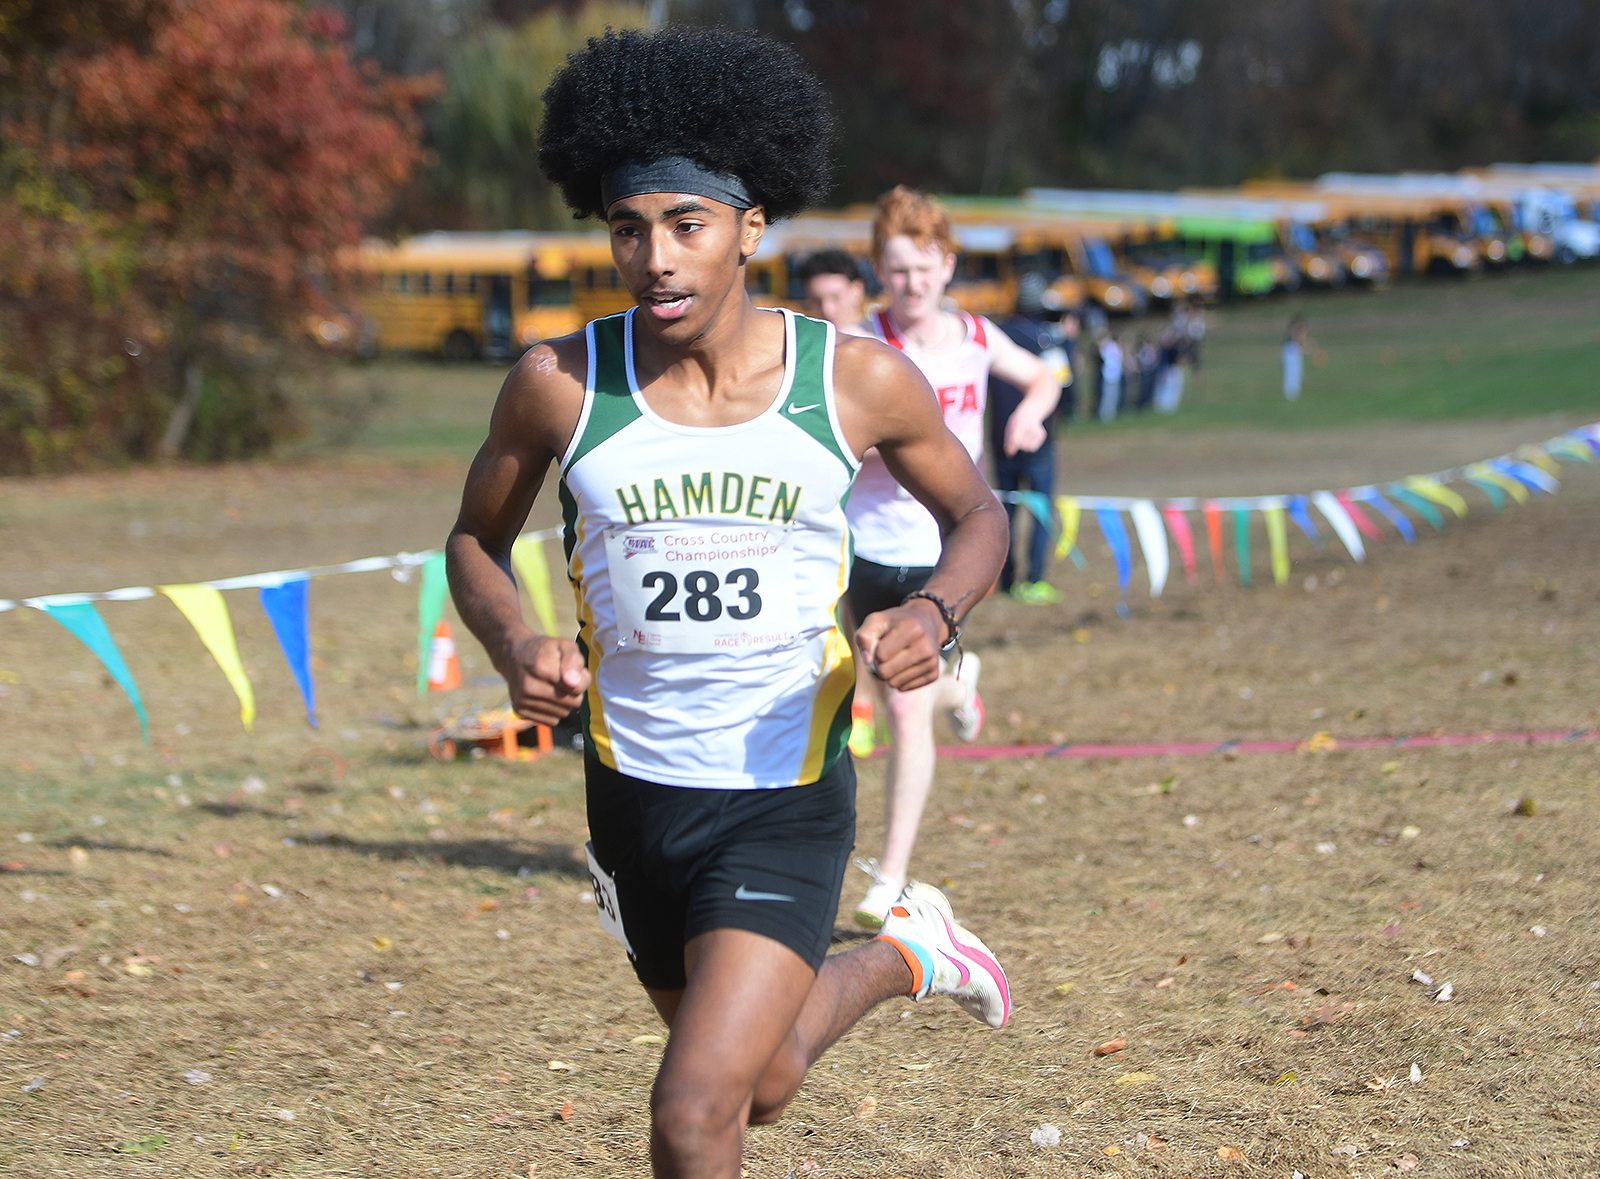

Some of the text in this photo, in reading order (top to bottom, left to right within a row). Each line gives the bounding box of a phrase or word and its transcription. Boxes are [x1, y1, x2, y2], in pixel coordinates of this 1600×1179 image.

[937, 384, 978, 415] FA
[615, 472, 802, 525] HAMDEN
[664, 531, 769, 547] Cross Country
[665, 545, 777, 562] Championships
[641, 567, 762, 622] 283
[714, 637, 740, 648] RACE
[753, 632, 788, 645] RESULT
[591, 873, 616, 922] 83
